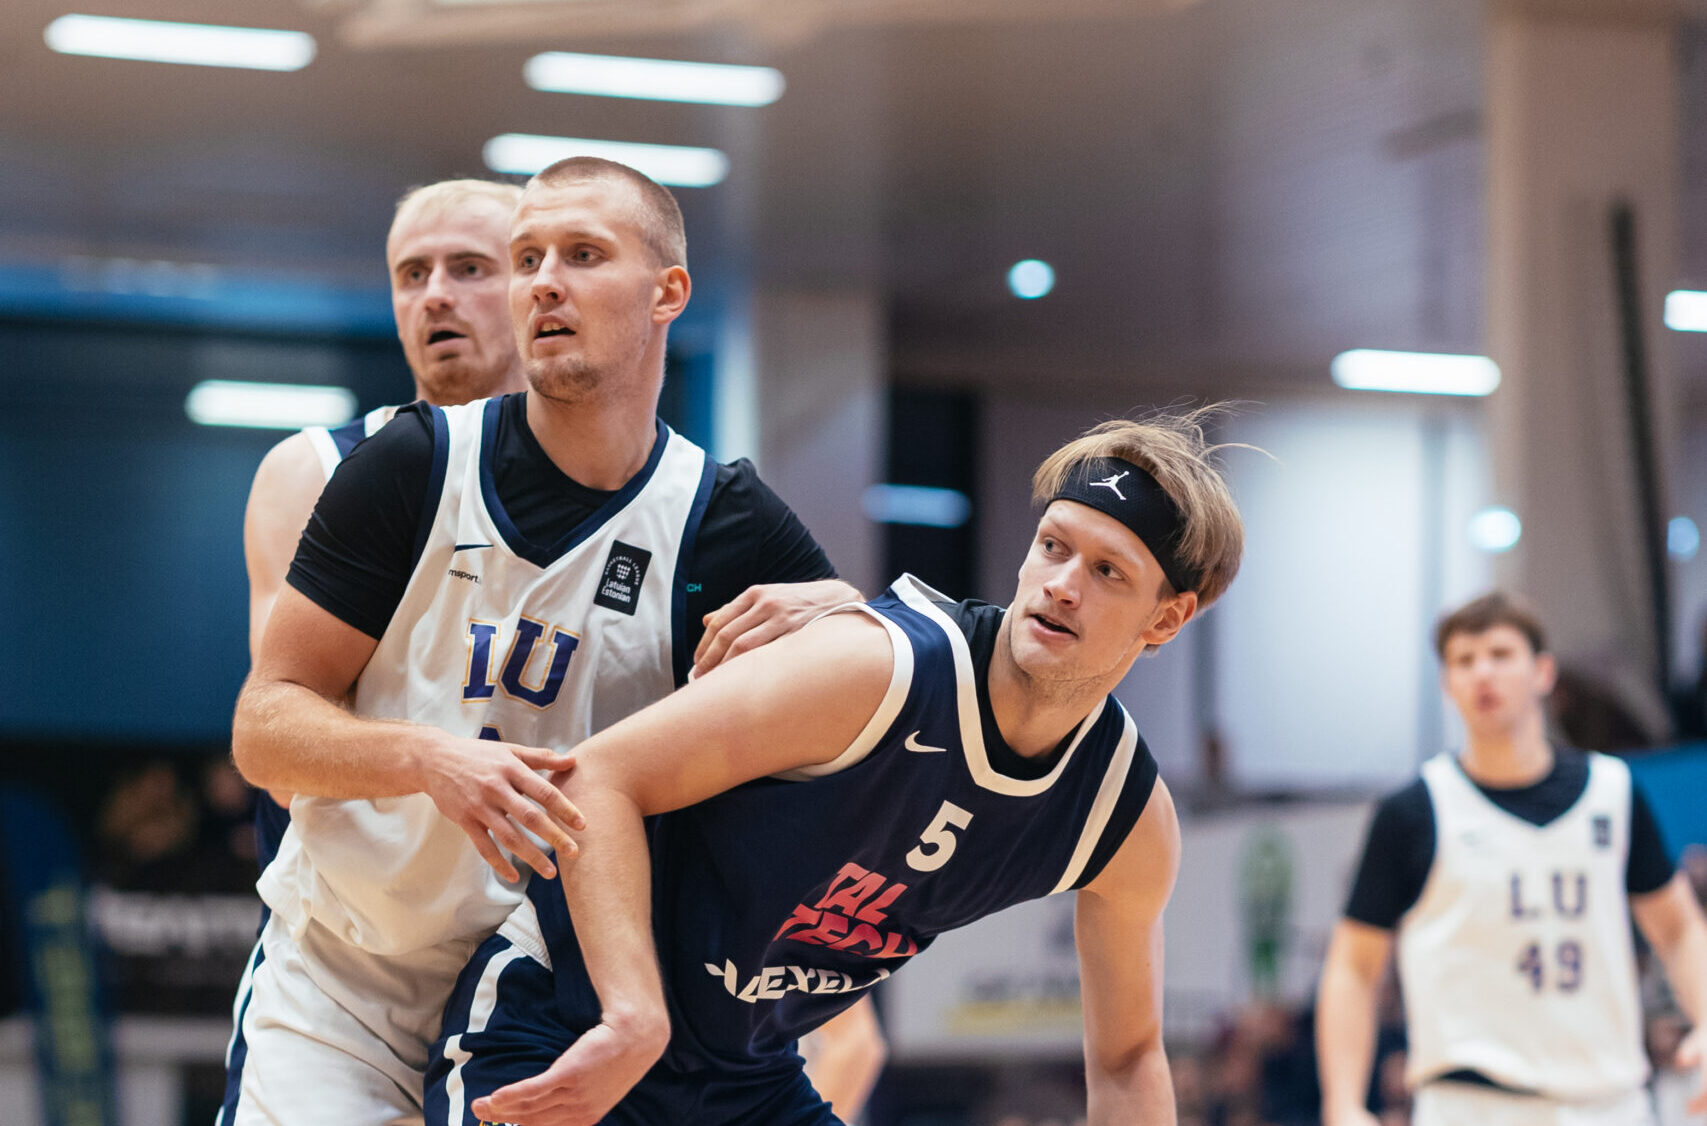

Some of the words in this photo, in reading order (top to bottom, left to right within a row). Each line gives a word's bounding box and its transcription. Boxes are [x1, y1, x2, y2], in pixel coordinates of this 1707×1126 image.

[601, 585, 631, 603] Estonian
[906, 800, 974, 872] 5
[814, 862, 908, 925] TAL
[1508, 870, 1588, 920] LU
[1517, 941, 1584, 993] 49
